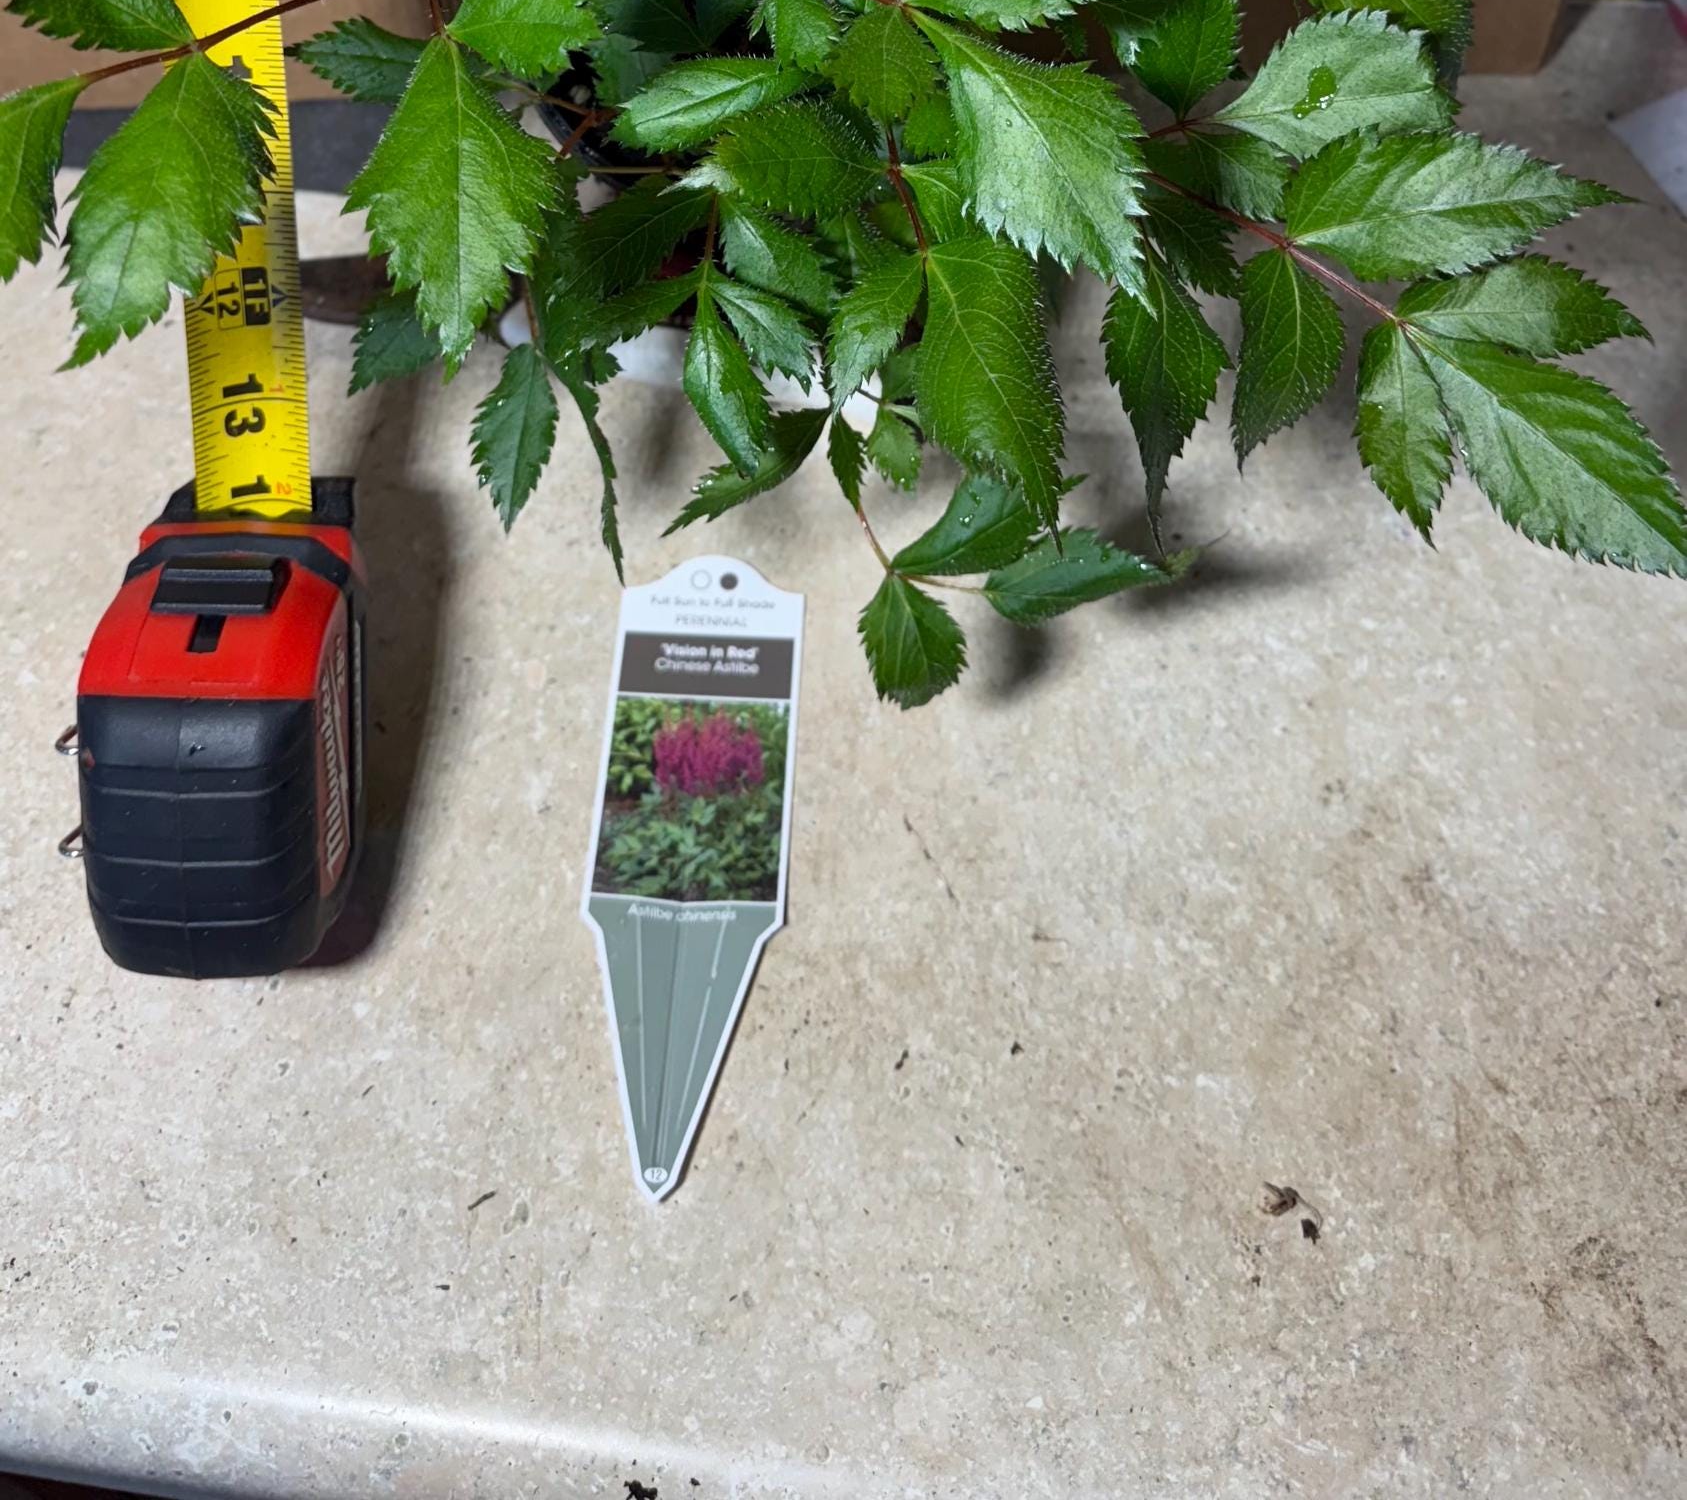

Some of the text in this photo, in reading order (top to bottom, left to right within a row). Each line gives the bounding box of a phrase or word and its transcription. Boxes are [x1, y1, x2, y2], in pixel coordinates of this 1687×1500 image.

[217, 281, 241, 319] 12
[231, 475, 272, 499] 1
[276, 483, 292, 496] 2
[675, 614, 748, 627] PERENNIAL
[709, 645, 725, 659] in
[654, 657, 760, 675] Chinese Astilbe
[320, 673, 345, 876] Milwaukee
[627, 902, 737, 922] Astilbe chinensis
